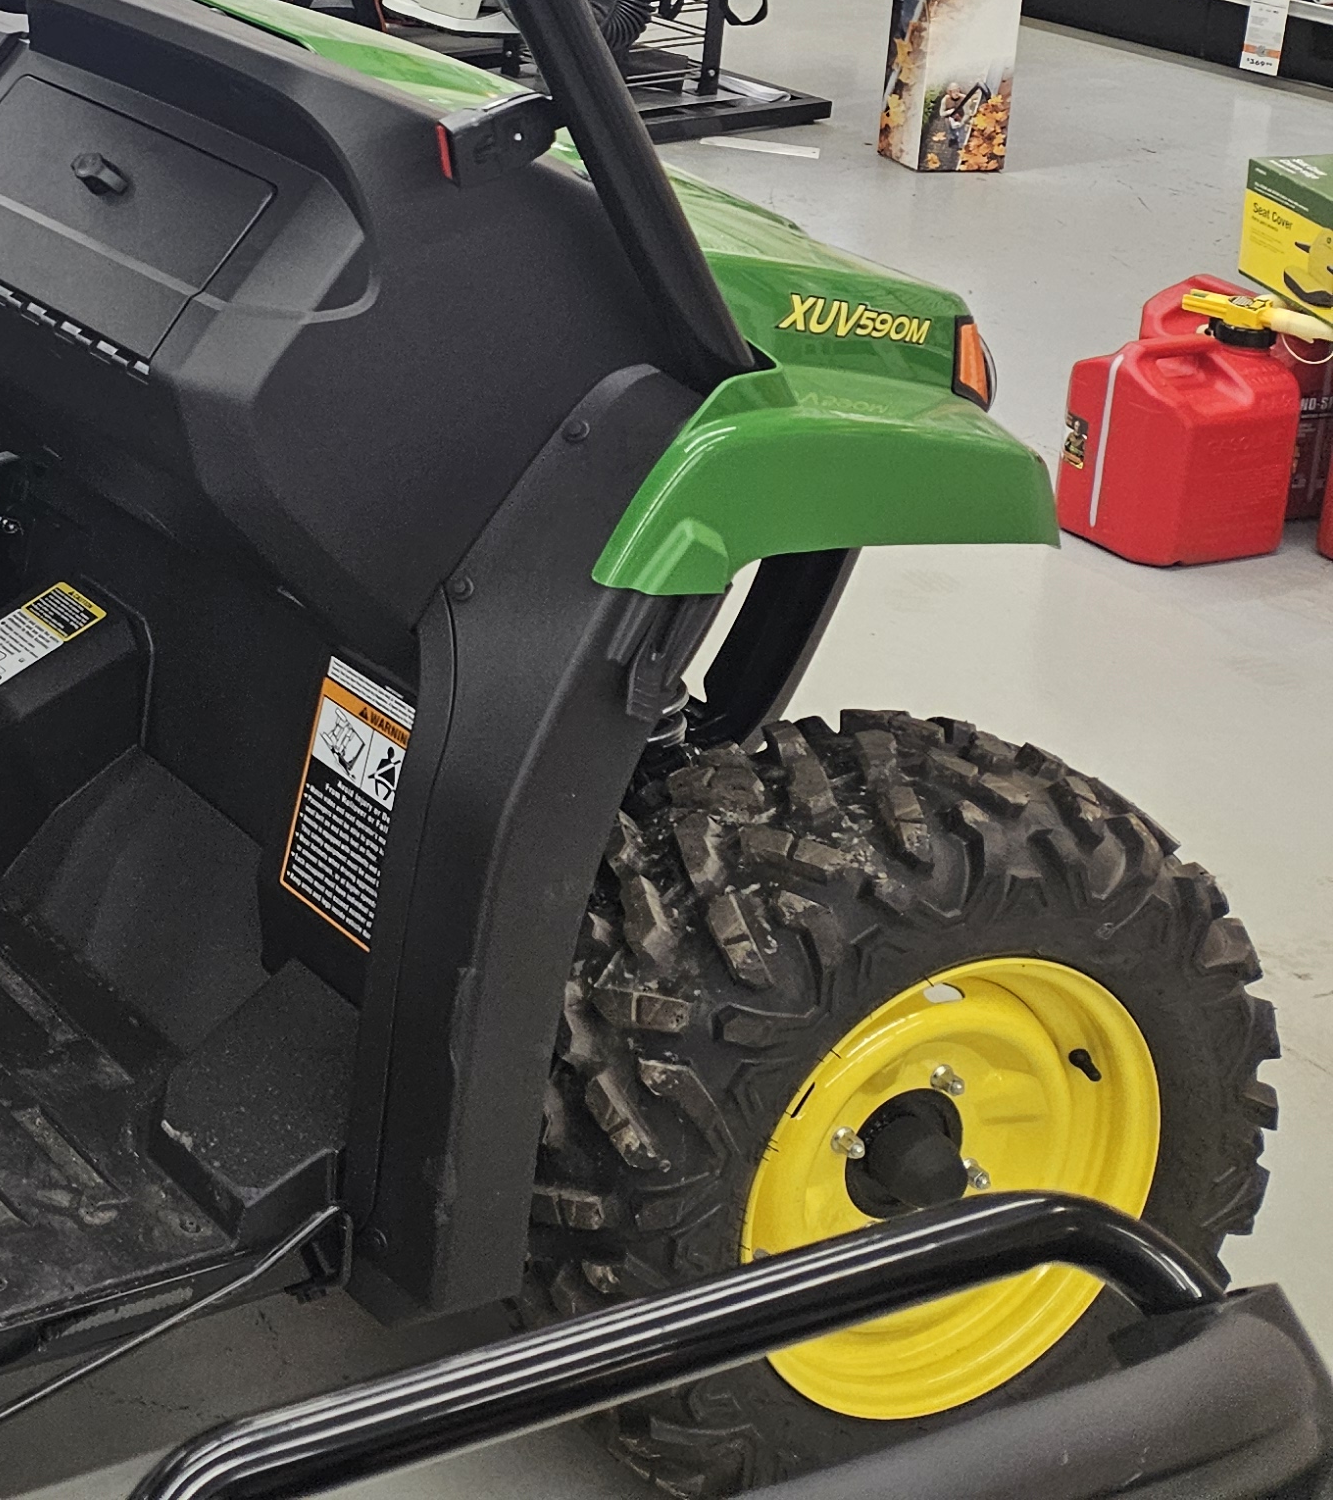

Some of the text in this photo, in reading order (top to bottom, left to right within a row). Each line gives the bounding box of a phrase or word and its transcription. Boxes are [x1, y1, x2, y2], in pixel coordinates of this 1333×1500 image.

[1253, 202, 1293, 231] Seat Cover
[775, 293, 932, 345] XUV590M
[369, 710, 407, 747] WARNIN
